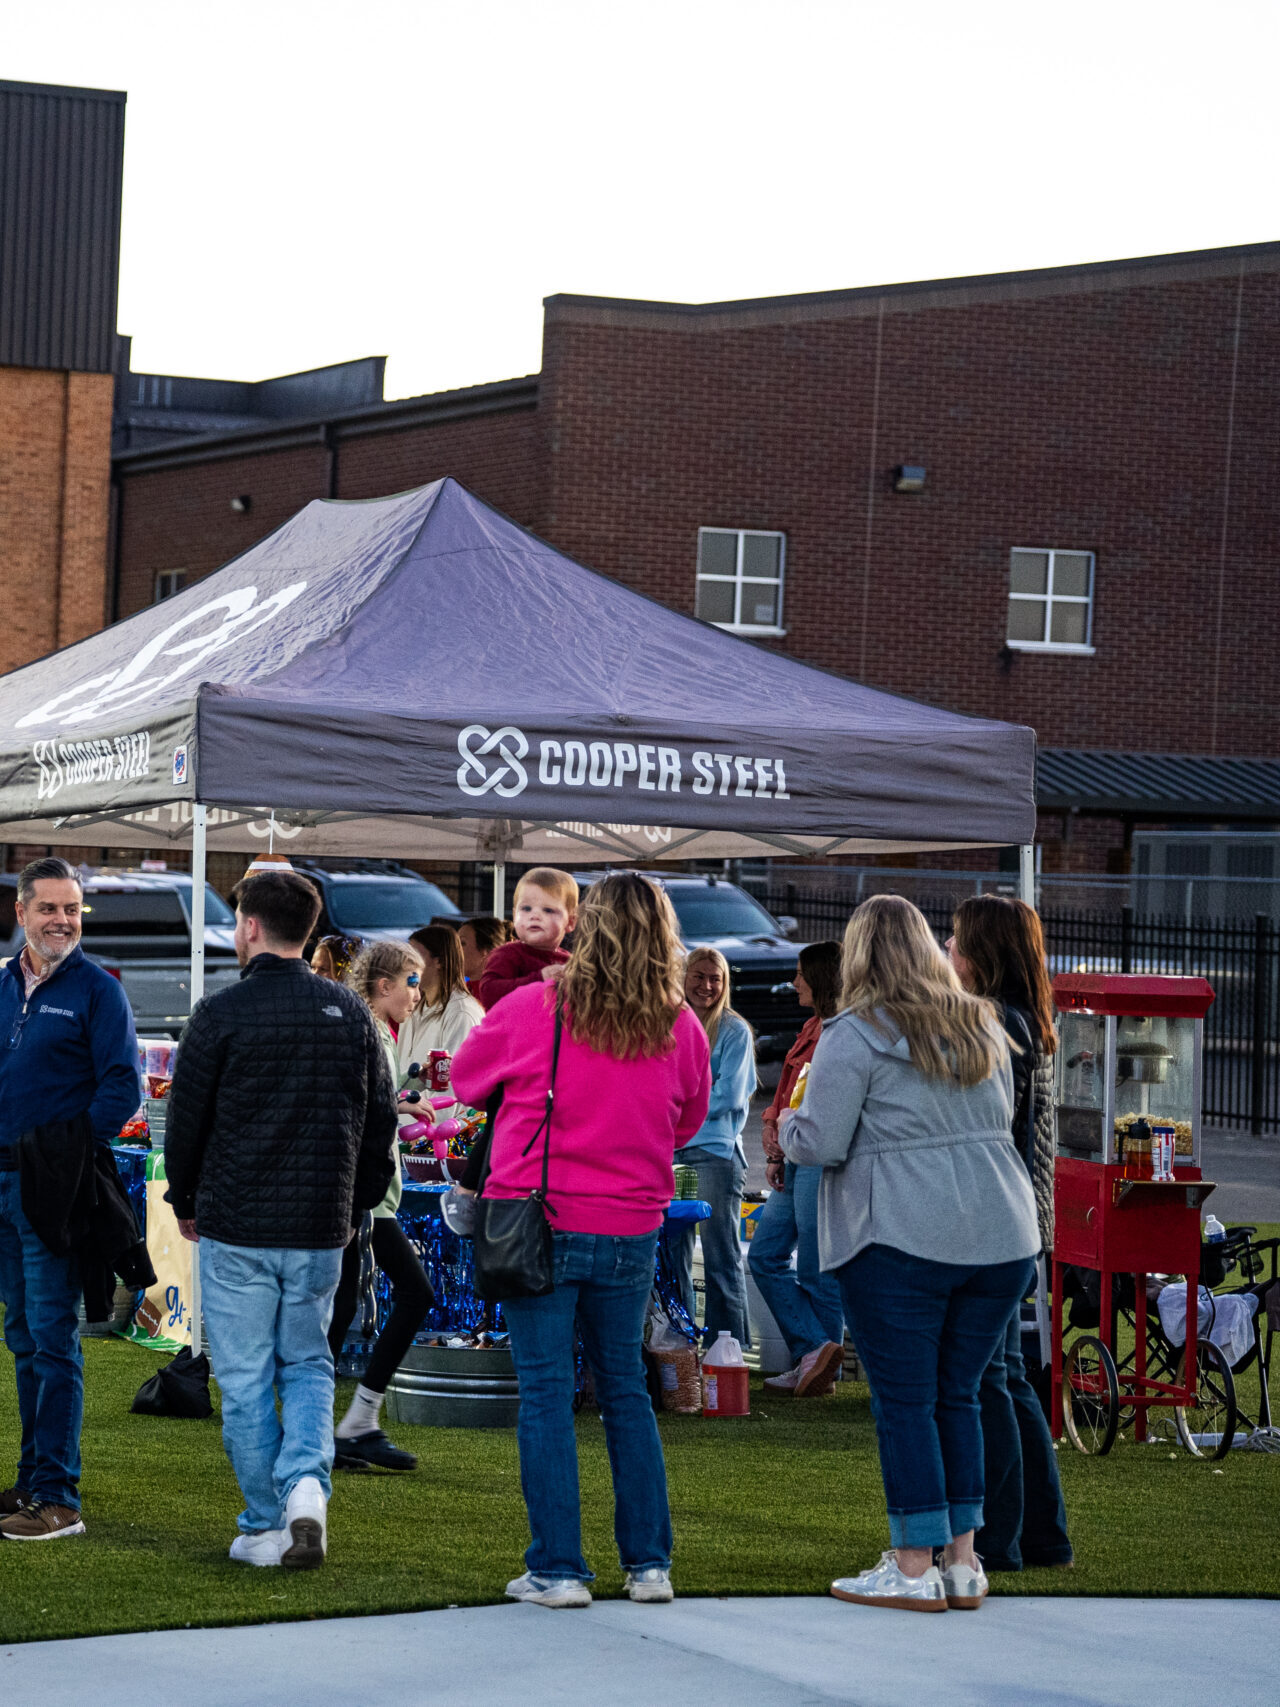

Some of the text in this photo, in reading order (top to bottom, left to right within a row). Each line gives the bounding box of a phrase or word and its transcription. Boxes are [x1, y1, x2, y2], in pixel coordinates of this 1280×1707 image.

[58, 738, 115, 785] COOPER
[114, 731, 150, 780] STEEL
[538, 740, 791, 800] COOPER STEEL
